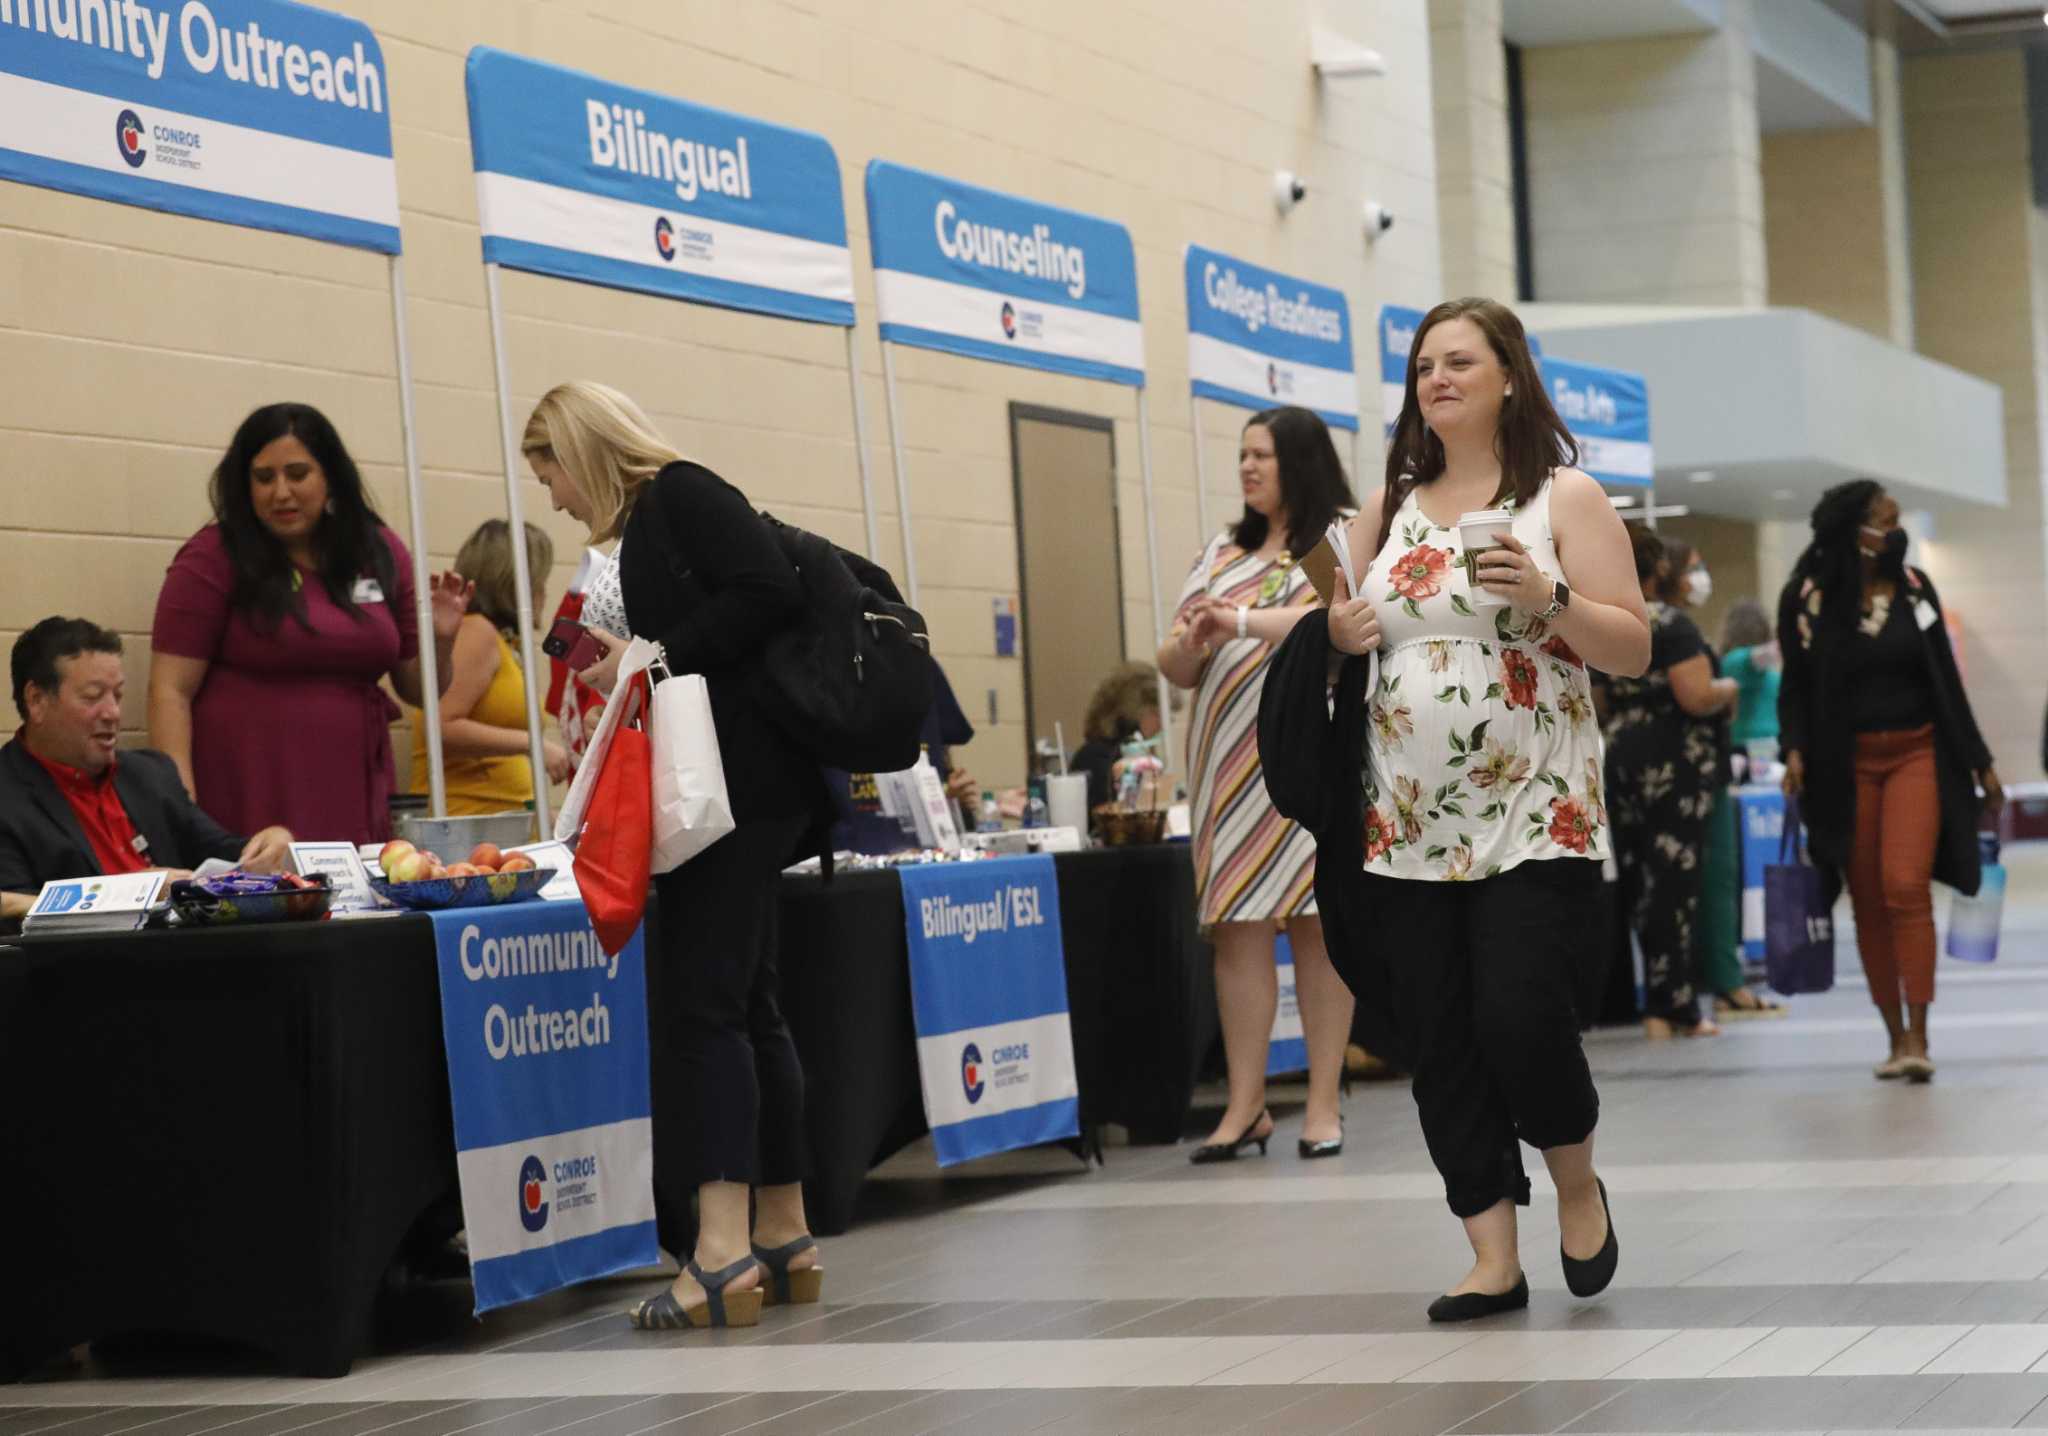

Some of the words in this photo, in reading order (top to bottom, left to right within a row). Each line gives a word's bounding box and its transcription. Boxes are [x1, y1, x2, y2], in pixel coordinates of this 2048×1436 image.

[180, 0, 383, 113] Outreach
[153, 125, 201, 149] CONROE
[586, 98, 752, 202] Bilingual
[934, 199, 1086, 299] Counseling
[1204, 261, 1266, 333] College
[1266, 282, 1342, 344] Readiness
[920, 884, 1044, 943] Bilingual/ESL
[484, 991, 611, 1060] Outreach
[553, 1155, 597, 1183] CONROE
